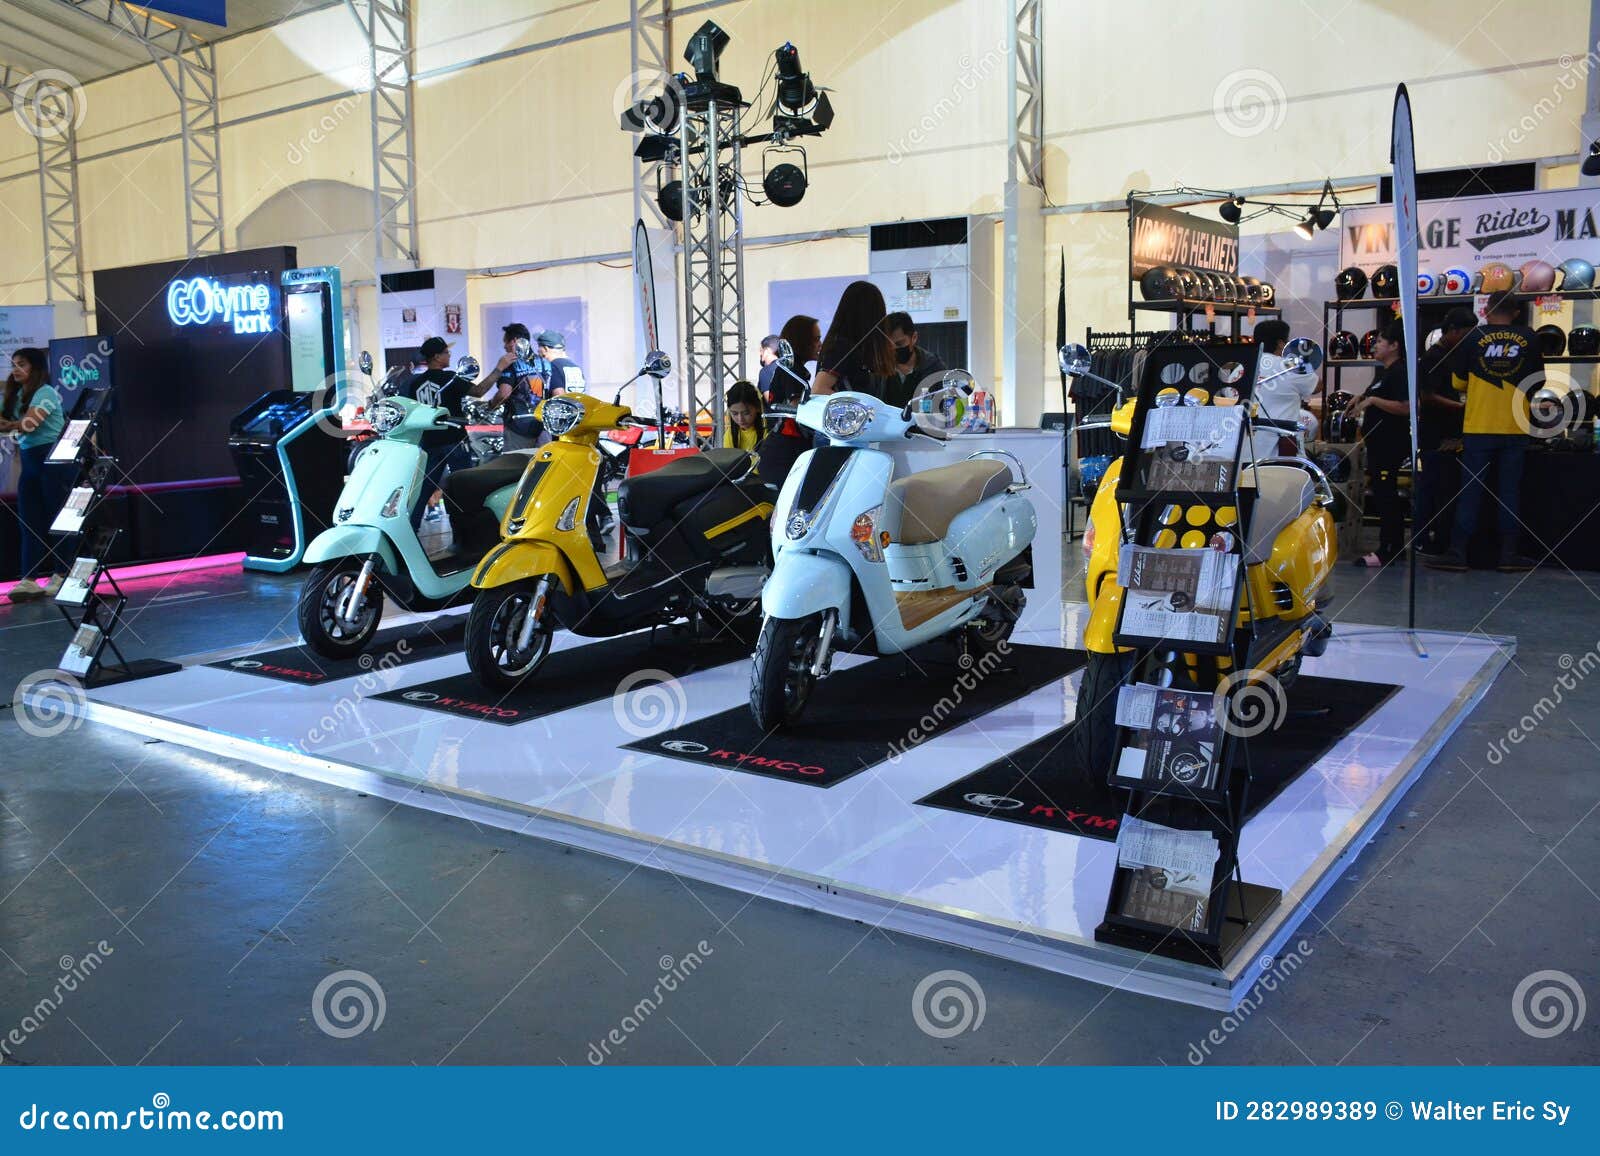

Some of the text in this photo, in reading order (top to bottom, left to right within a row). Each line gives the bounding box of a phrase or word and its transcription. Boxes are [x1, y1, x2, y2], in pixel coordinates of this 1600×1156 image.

[1348, 218, 1461, 254] VINGE
[1475, 208, 1538, 235] Rider
[1189, 230, 1238, 274] HELMETS
[168, 277, 270, 326] GOtyme
[233, 311, 273, 334] bank
[1478, 332, 1529, 348] MOTOSHED
[257, 664, 324, 680] KYMCO
[435, 696, 519, 718] KYMCO
[708, 748, 826, 777] KYMCO
[1029, 803, 1118, 830] KYM
